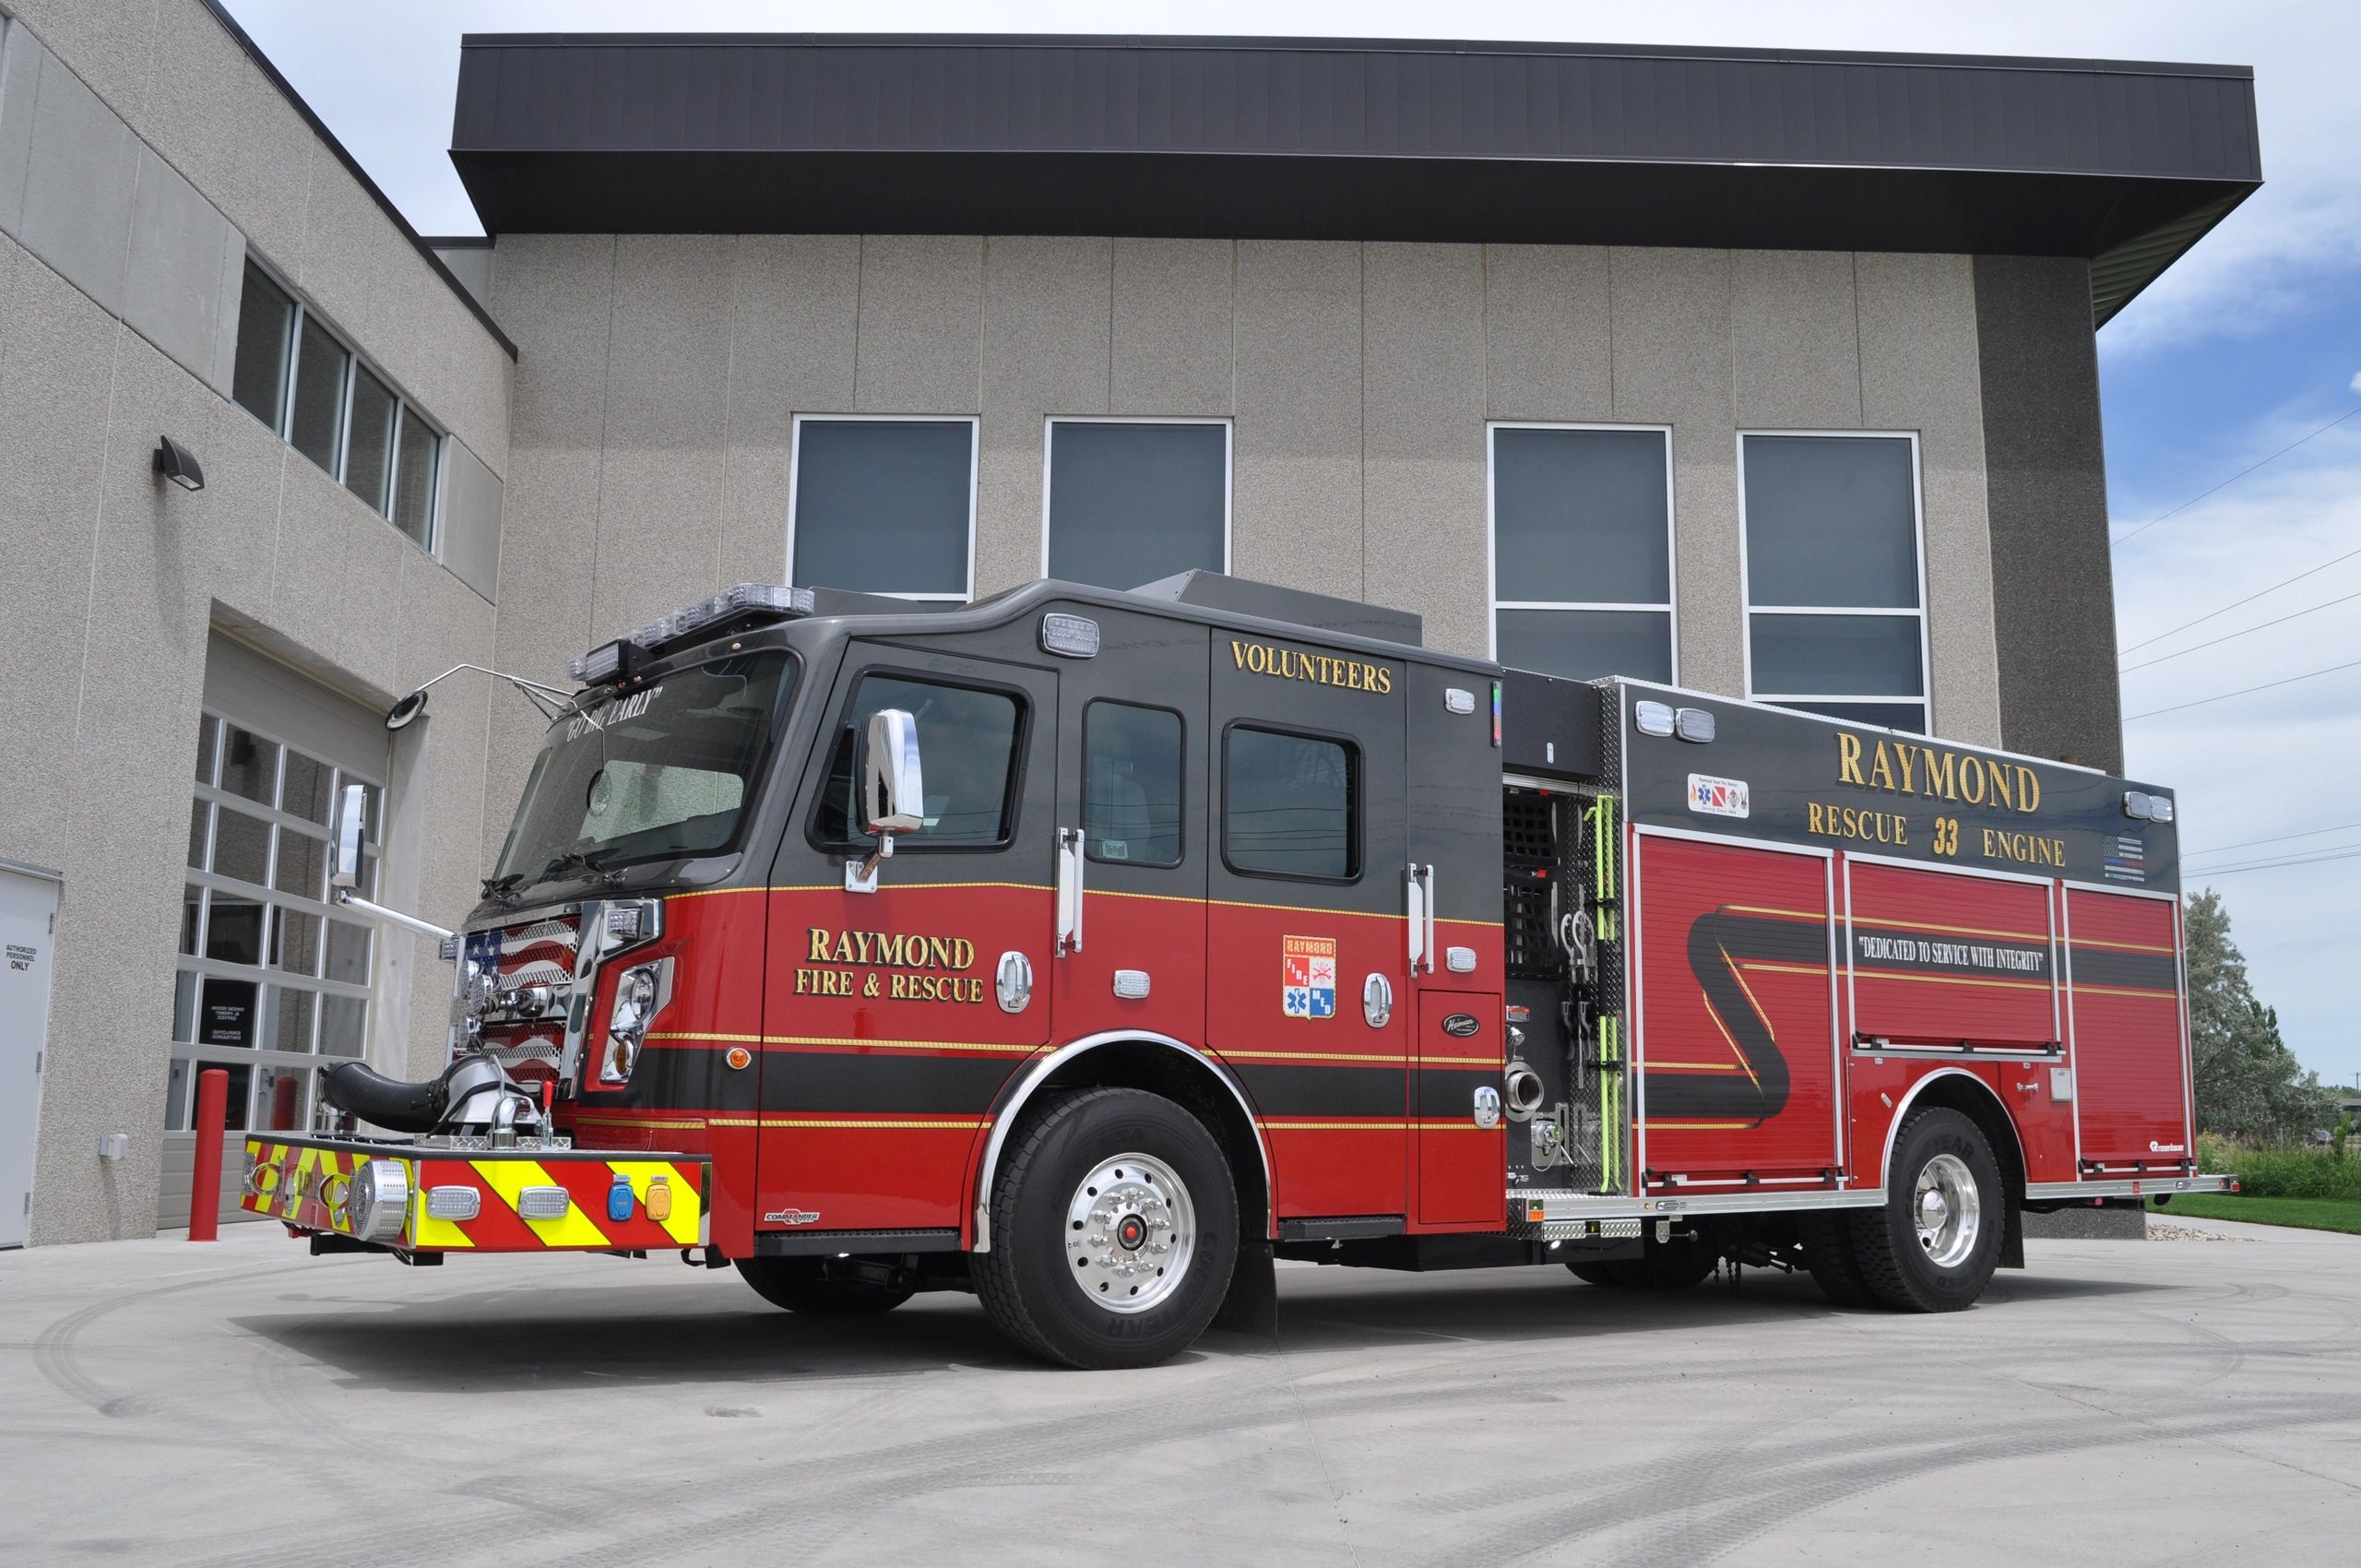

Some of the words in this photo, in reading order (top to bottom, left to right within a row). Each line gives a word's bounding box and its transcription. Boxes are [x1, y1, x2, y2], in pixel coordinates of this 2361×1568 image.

[1231, 640, 1392, 695] VOLUNTEERS
[1835, 731, 2041, 814] RAYMOND
[1807, 802, 1908, 846] RESCUE
[1932, 816, 1959, 857] 33
[1982, 827, 2066, 868] ENGINE
[6, 944, 37, 956] AUTHORIZED
[6, 952, 35, 962] PERSONNEL
[808, 927, 975, 969] RAYMOND
[1286, 939, 1334, 955] RAYMOND
[1917, 941, 1930, 963] TO
[1932, 943, 1969, 966] SERVICE
[1971, 945, 1994, 968] WITH
[10, 960, 30, 971] ONLY
[1287, 958, 1309, 985] FIRE
[795, 968, 854, 996] FIRE
[862, 972, 881, 998] &
[890, 974, 984, 1004] RESCUE
[1312, 989, 1332, 1015] MED
